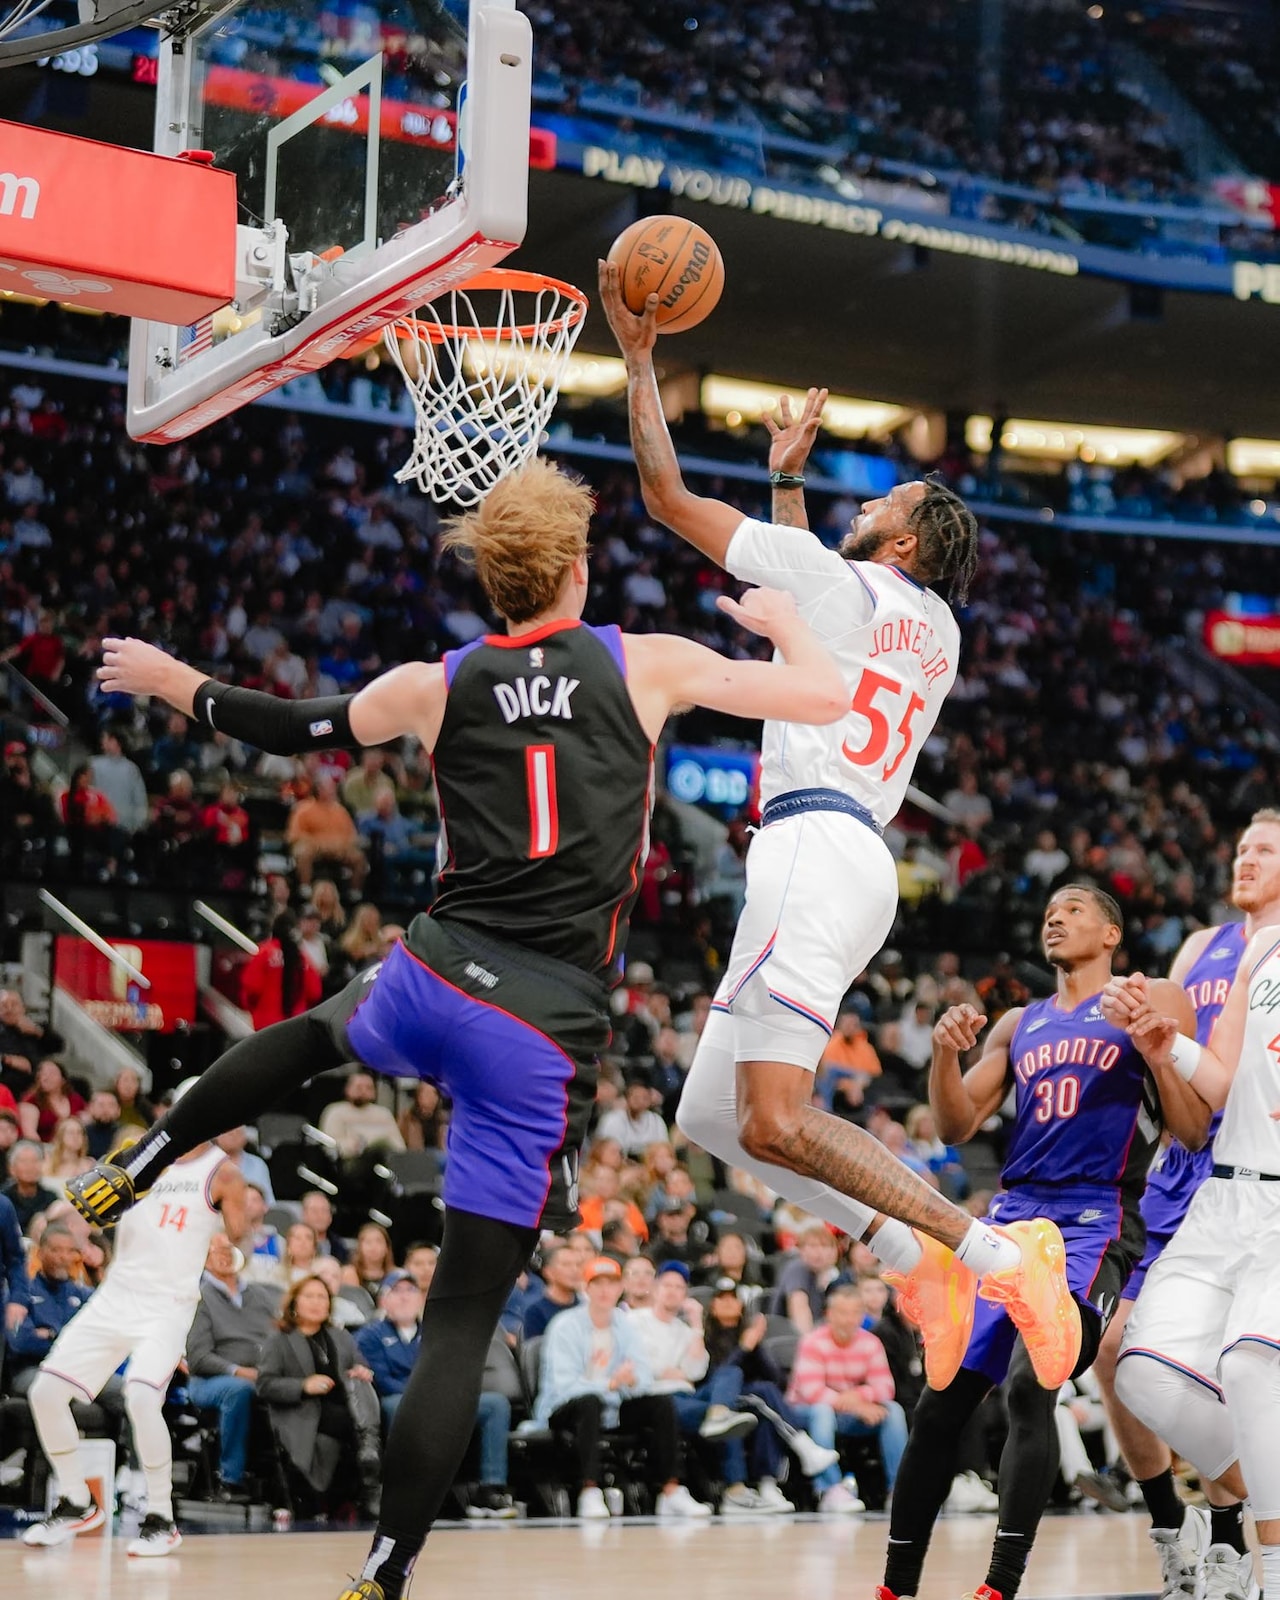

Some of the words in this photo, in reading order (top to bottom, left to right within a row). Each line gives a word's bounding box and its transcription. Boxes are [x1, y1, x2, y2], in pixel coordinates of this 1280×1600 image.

[583, 146, 665, 189] PLAY
[668, 165, 751, 208] YOUR
[751, 186, 883, 237] PERFECT
[661, 240, 710, 309] Wilson
[492, 674, 581, 724] DICK
[842, 667, 926, 783] 55
[525, 743, 559, 859] 1
[463, 960, 500, 989] RAPTORS
[1016, 1036, 1121, 1086] TORONTO
[1034, 1074, 1081, 1124] 30
[158, 1203, 189, 1233] 14
